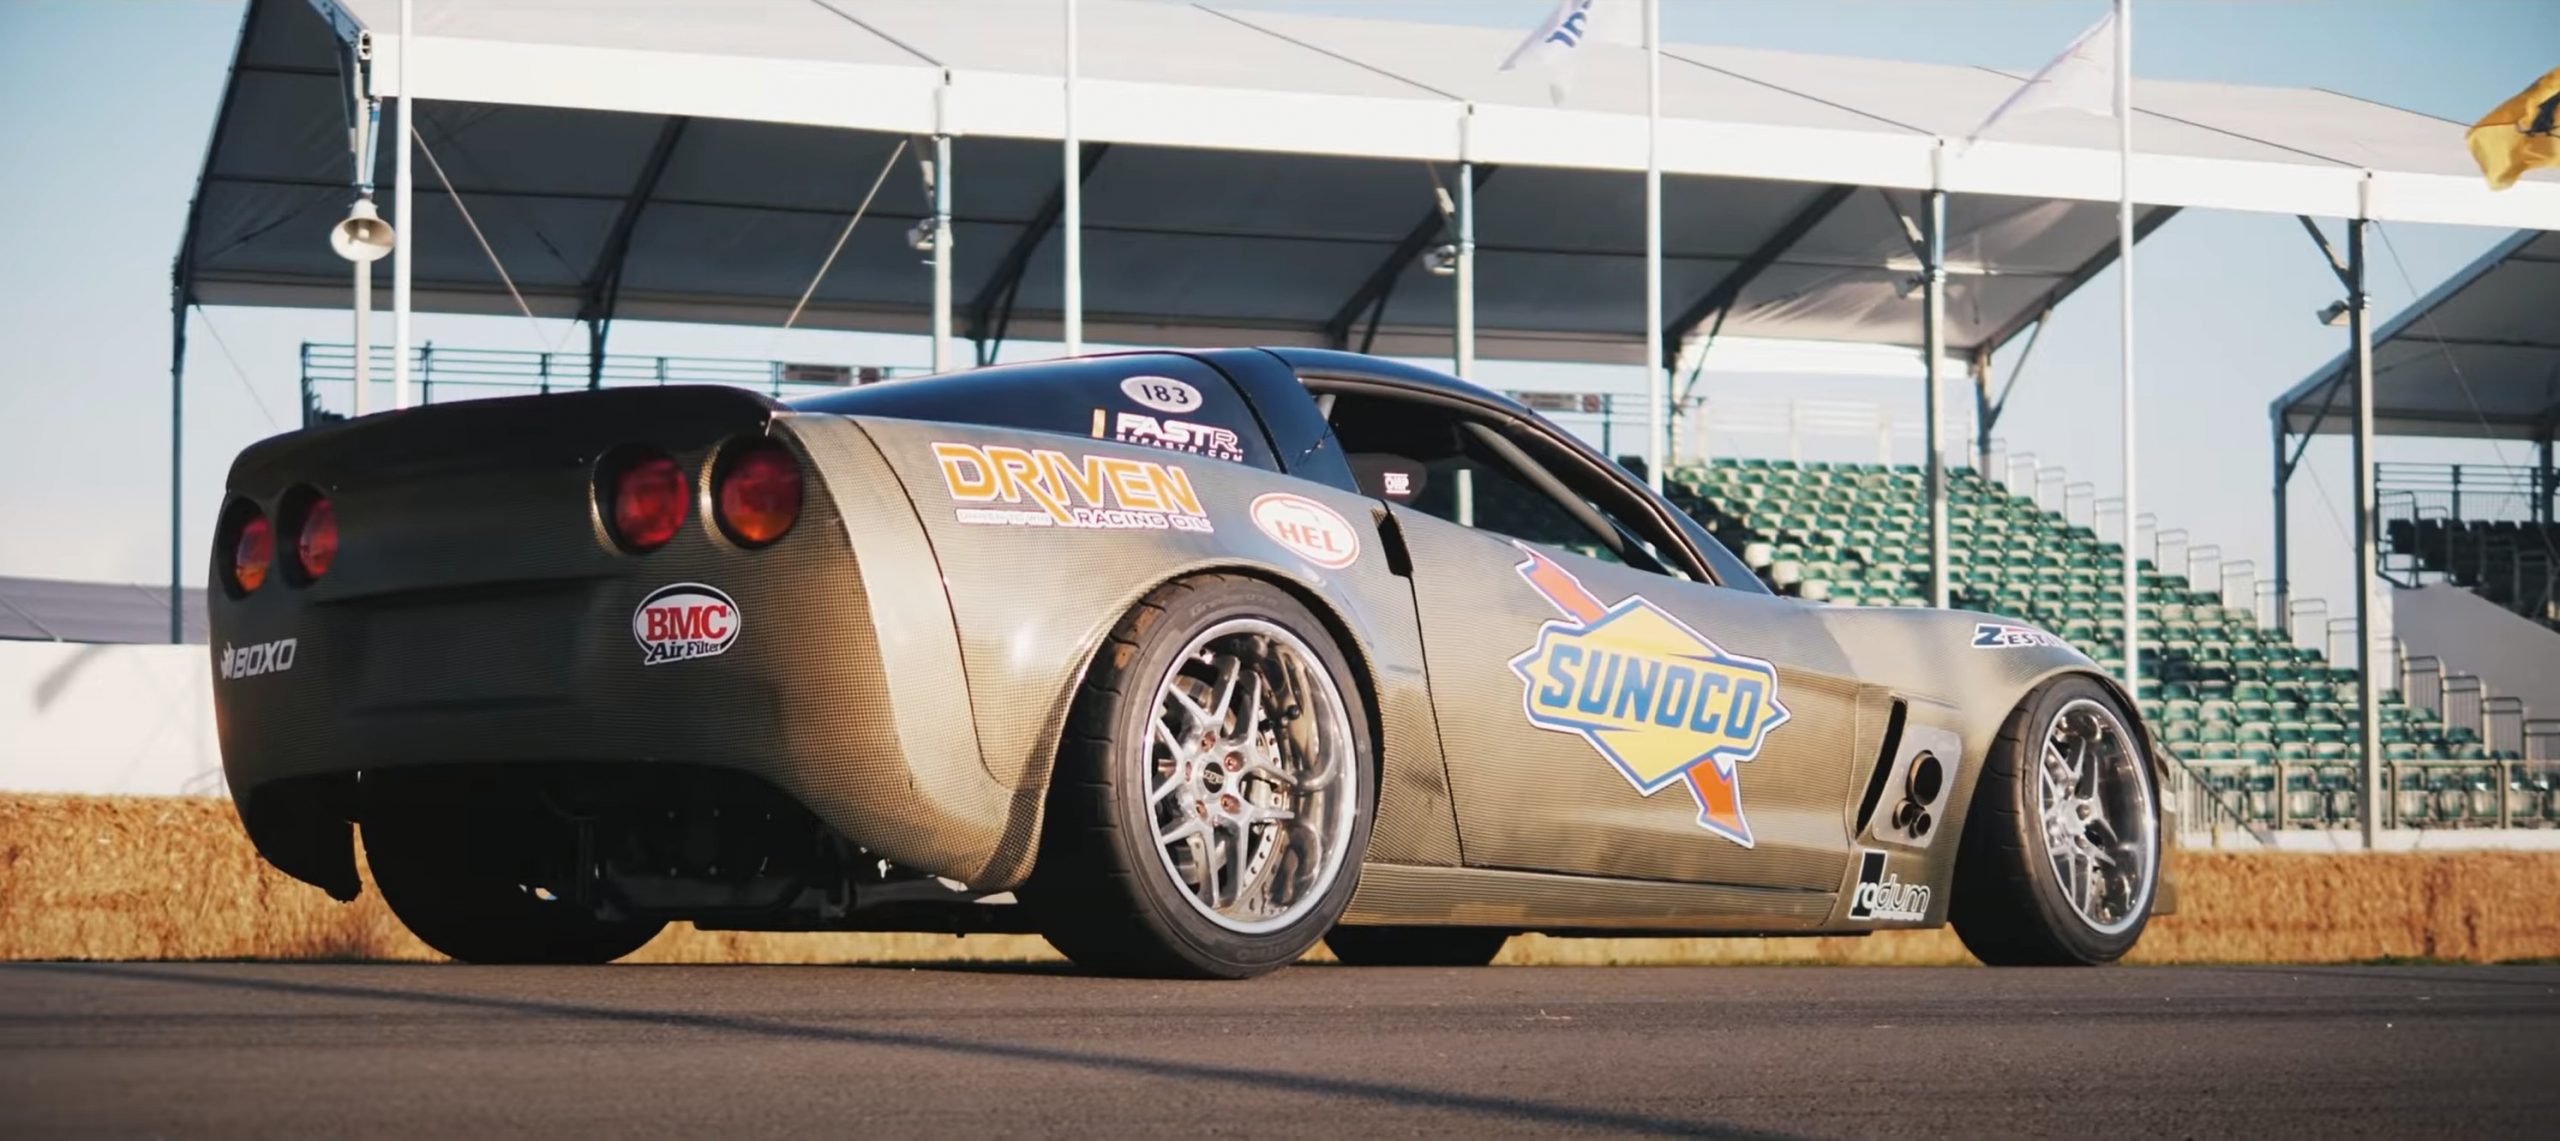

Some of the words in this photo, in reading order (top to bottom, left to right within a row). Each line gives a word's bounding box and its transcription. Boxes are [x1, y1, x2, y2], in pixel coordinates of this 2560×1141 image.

[1141, 384, 1189, 405] 183
[931, 442, 1207, 525] DRIVEN
[1076, 509, 1168, 528] RACING
[1277, 520, 1343, 554] HEL
[645, 604, 728, 642] BMC
[232, 638, 298, 680] BOXO
[647, 641, 685, 662] Air
[686, 640, 722, 657] Filter
[1539, 643, 1764, 741] SUNOCO
